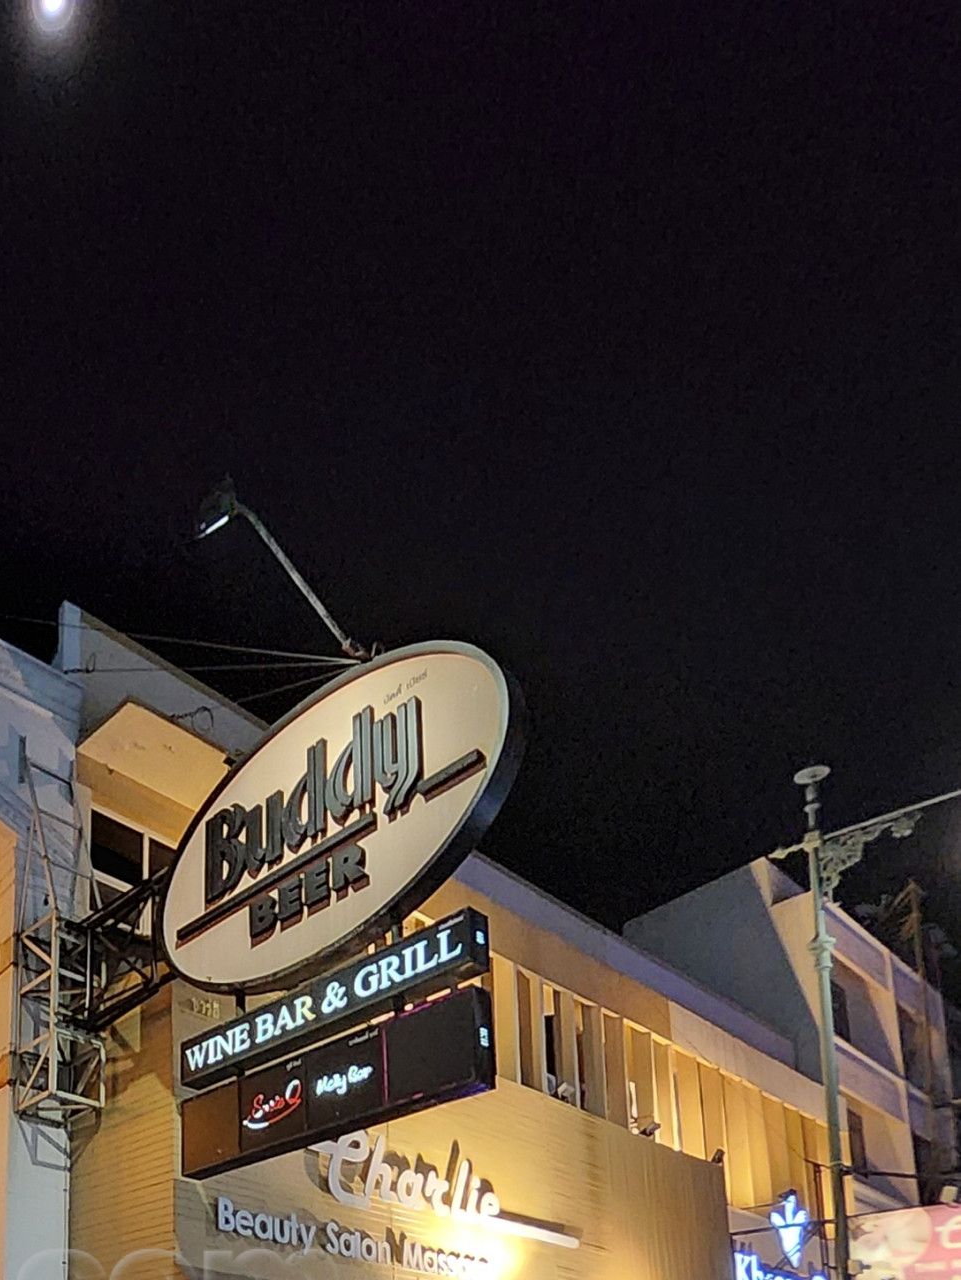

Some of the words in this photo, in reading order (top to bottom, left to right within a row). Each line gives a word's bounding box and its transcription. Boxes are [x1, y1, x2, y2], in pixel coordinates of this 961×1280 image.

[205, 696, 423, 908] Buddy
[250, 843, 370, 946] BEER
[185, 1023, 250, 1072] WINE
[255, 995, 316, 1043] BAR
[321, 981, 347, 1014] &
[354, 929, 463, 998] GRILL
[307, 1130, 500, 1217] Charlie
[217, 1197, 316, 1250] Beauty
[326, 1220, 391, 1264] Salon
